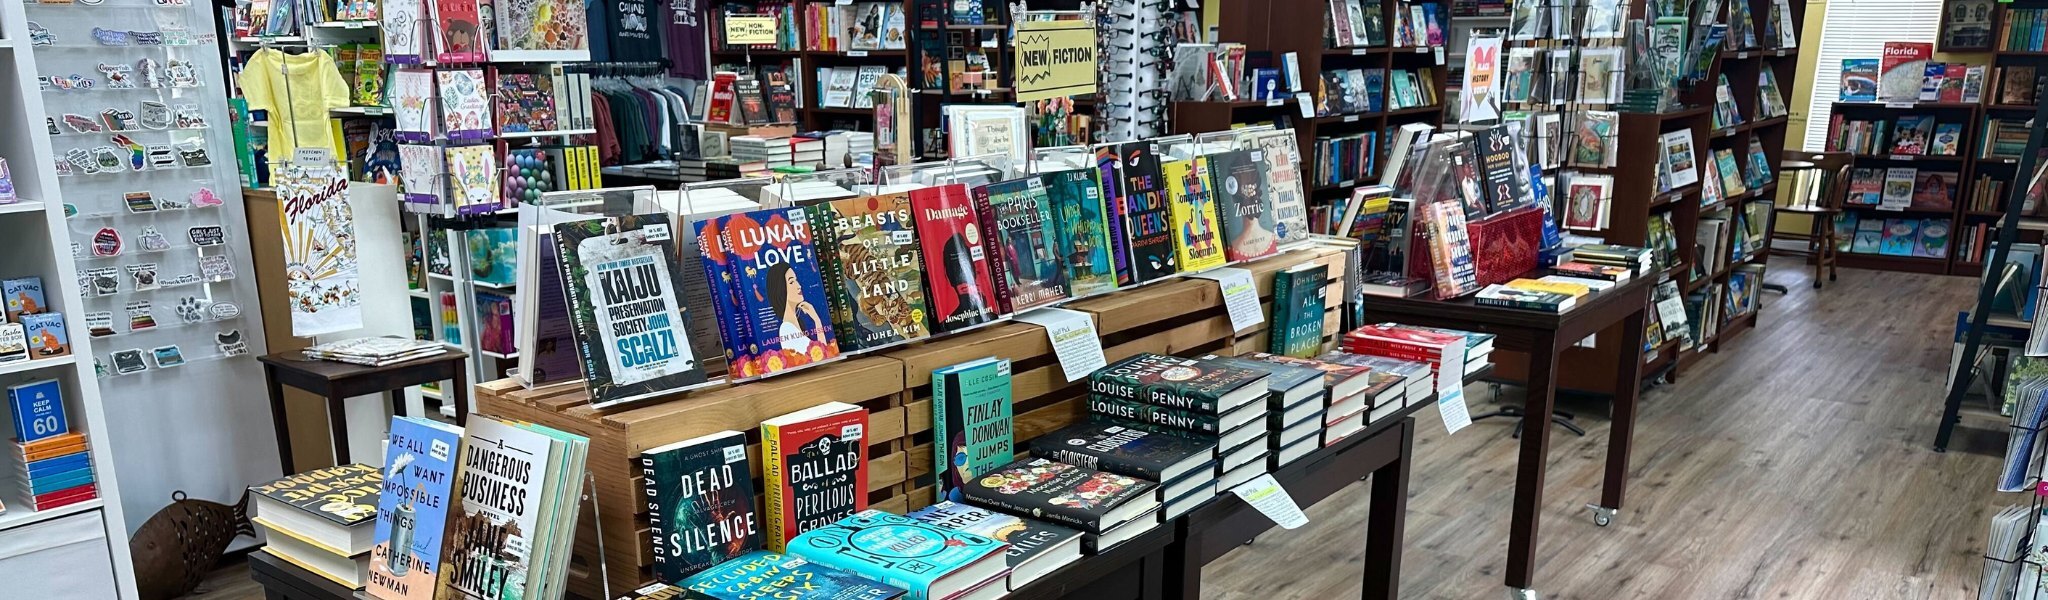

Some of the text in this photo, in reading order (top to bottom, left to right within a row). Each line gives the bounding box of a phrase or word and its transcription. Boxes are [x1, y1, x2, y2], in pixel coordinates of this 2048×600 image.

[1022, 46, 1092, 66] NEW FICTION
[1884, 46, 1918, 56] Florida
[1472, 74, 1490, 82] HISTORY
[986, 124, 1008, 134] Though
[1130, 174, 1153, 192] THE
[1182, 174, 1200, 188] Violin
[284, 176, 348, 221] Florida
[1007, 192, 1038, 213] PARIS
[1176, 189, 1211, 205] Conspiracy
[925, 203, 968, 221] Damage
[997, 210, 1051, 230] BOOKSELLER
[1234, 200, 1264, 218] Zorrie
[838, 210, 908, 231] BEASTS
[1127, 210, 1168, 240] QUEENS
[696, 235, 706, 257] LOVE
[700, 231, 711, 259] LUNAR
[720, 230, 730, 252] LOVE
[724, 226, 735, 254] LUNAR
[740, 224, 806, 248] LUNAR
[862, 236, 892, 249] OF A
[1149, 234, 1169, 245] SHROFF
[1186, 231, 1214, 244] Brendan
[754, 245, 805, 270] LOVE
[1188, 244, 1218, 260] Slocumb
[619, 260, 631, 268] TIMES
[822, 210, 848, 317] BEASTS LITTLE LAND
[851, 254, 911, 276] LITTLE
[989, 237, 1007, 300] PARIS BOOKSELLER
[8, 284, 39, 294] CAT VAC
[598, 264, 662, 306] KAIJU
[862, 280, 910, 299] LAND
[1038, 284, 1065, 300] MAHER
[1293, 276, 1310, 288] JOHN
[706, 264, 728, 342] LAUREN KUNG JESSEN
[731, 260, 741, 288] LAUREN
[743, 312, 753, 338] JESSEN
[1016, 291, 1036, 306] KERRI
[1302, 294, 1316, 308] ALL
[558, 244, 568, 264] KAIJU
[564, 262, 580, 310] PRESERVATION
[575, 310, 586, 336] SOCIETY
[581, 340, 589, 358] JOHN
[586, 358, 596, 381] SCALZI
[608, 298, 666, 322] PRESERVATION
[945, 308, 980, 324] Josephine
[1304, 310, 1314, 320] THE
[30, 322, 44, 331] CAT
[612, 313, 670, 338] SOCIETY JOHN
[762, 325, 832, 346] LAUREN KUNG JESSEN
[866, 323, 921, 342] JUHEA KIM
[1290, 318, 1322, 339] BROKEN
[616, 328, 676, 368] SCALZI
[1291, 336, 1320, 354] PLACES
[1106, 354, 1166, 378] LOUISE
[1125, 357, 1182, 380] PENNY
[33, 400, 50, 408] KEEP
[1091, 380, 1194, 409] LOUISE PENNY
[33, 404, 52, 414] CALM
[966, 397, 1004, 426] FINLAY
[1091, 400, 1196, 430] LOUISE PENNY
[33, 415, 58, 435] 60
[972, 416, 1010, 446] DONOVAN
[392, 433, 424, 455] WE ALL
[497, 439, 504, 450] A
[690, 450, 710, 460] GHOST
[976, 440, 1009, 461] JUMPS
[466, 444, 532, 485] DANGEROUS
[791, 452, 858, 484] BALLAD
[974, 461, 994, 478] THE
[1060, 449, 1098, 471] CLOISTERS
[414, 464, 445, 486] WANT
[681, 464, 734, 499] DEAD
[770, 440, 780, 516] BALLAD PERILOUS
[382, 478, 440, 509] IMPOSSIBLE
[461, 470, 527, 517] BUSINESS
[720, 499, 736, 508] CREW
[796, 484, 854, 520] PERILOUS
[379, 508, 414, 531] THINGS
[483, 510, 500, 521] NOVEL
[642, 458, 666, 564] DEAD SILENCE
[965, 494, 988, 504] Moonrise
[988, 499, 1000, 507] Over
[1013, 505, 1030, 514] Jessup
[1062, 515, 1083, 525] Minnicks
[464, 518, 508, 562] JANE
[670, 511, 757, 558] SILENCE
[888, 535, 928, 552] KILLED
[1008, 530, 1058, 557] EXILES
[376, 544, 431, 576] CATHERINE
[368, 569, 409, 596] NEWMAN
[450, 550, 510, 600] SMILEY
[688, 553, 782, 594] SECLUDED
[726, 566, 780, 594] CABIN
[738, 570, 814, 600] SLEEPS
[773, 582, 821, 600] SIX
